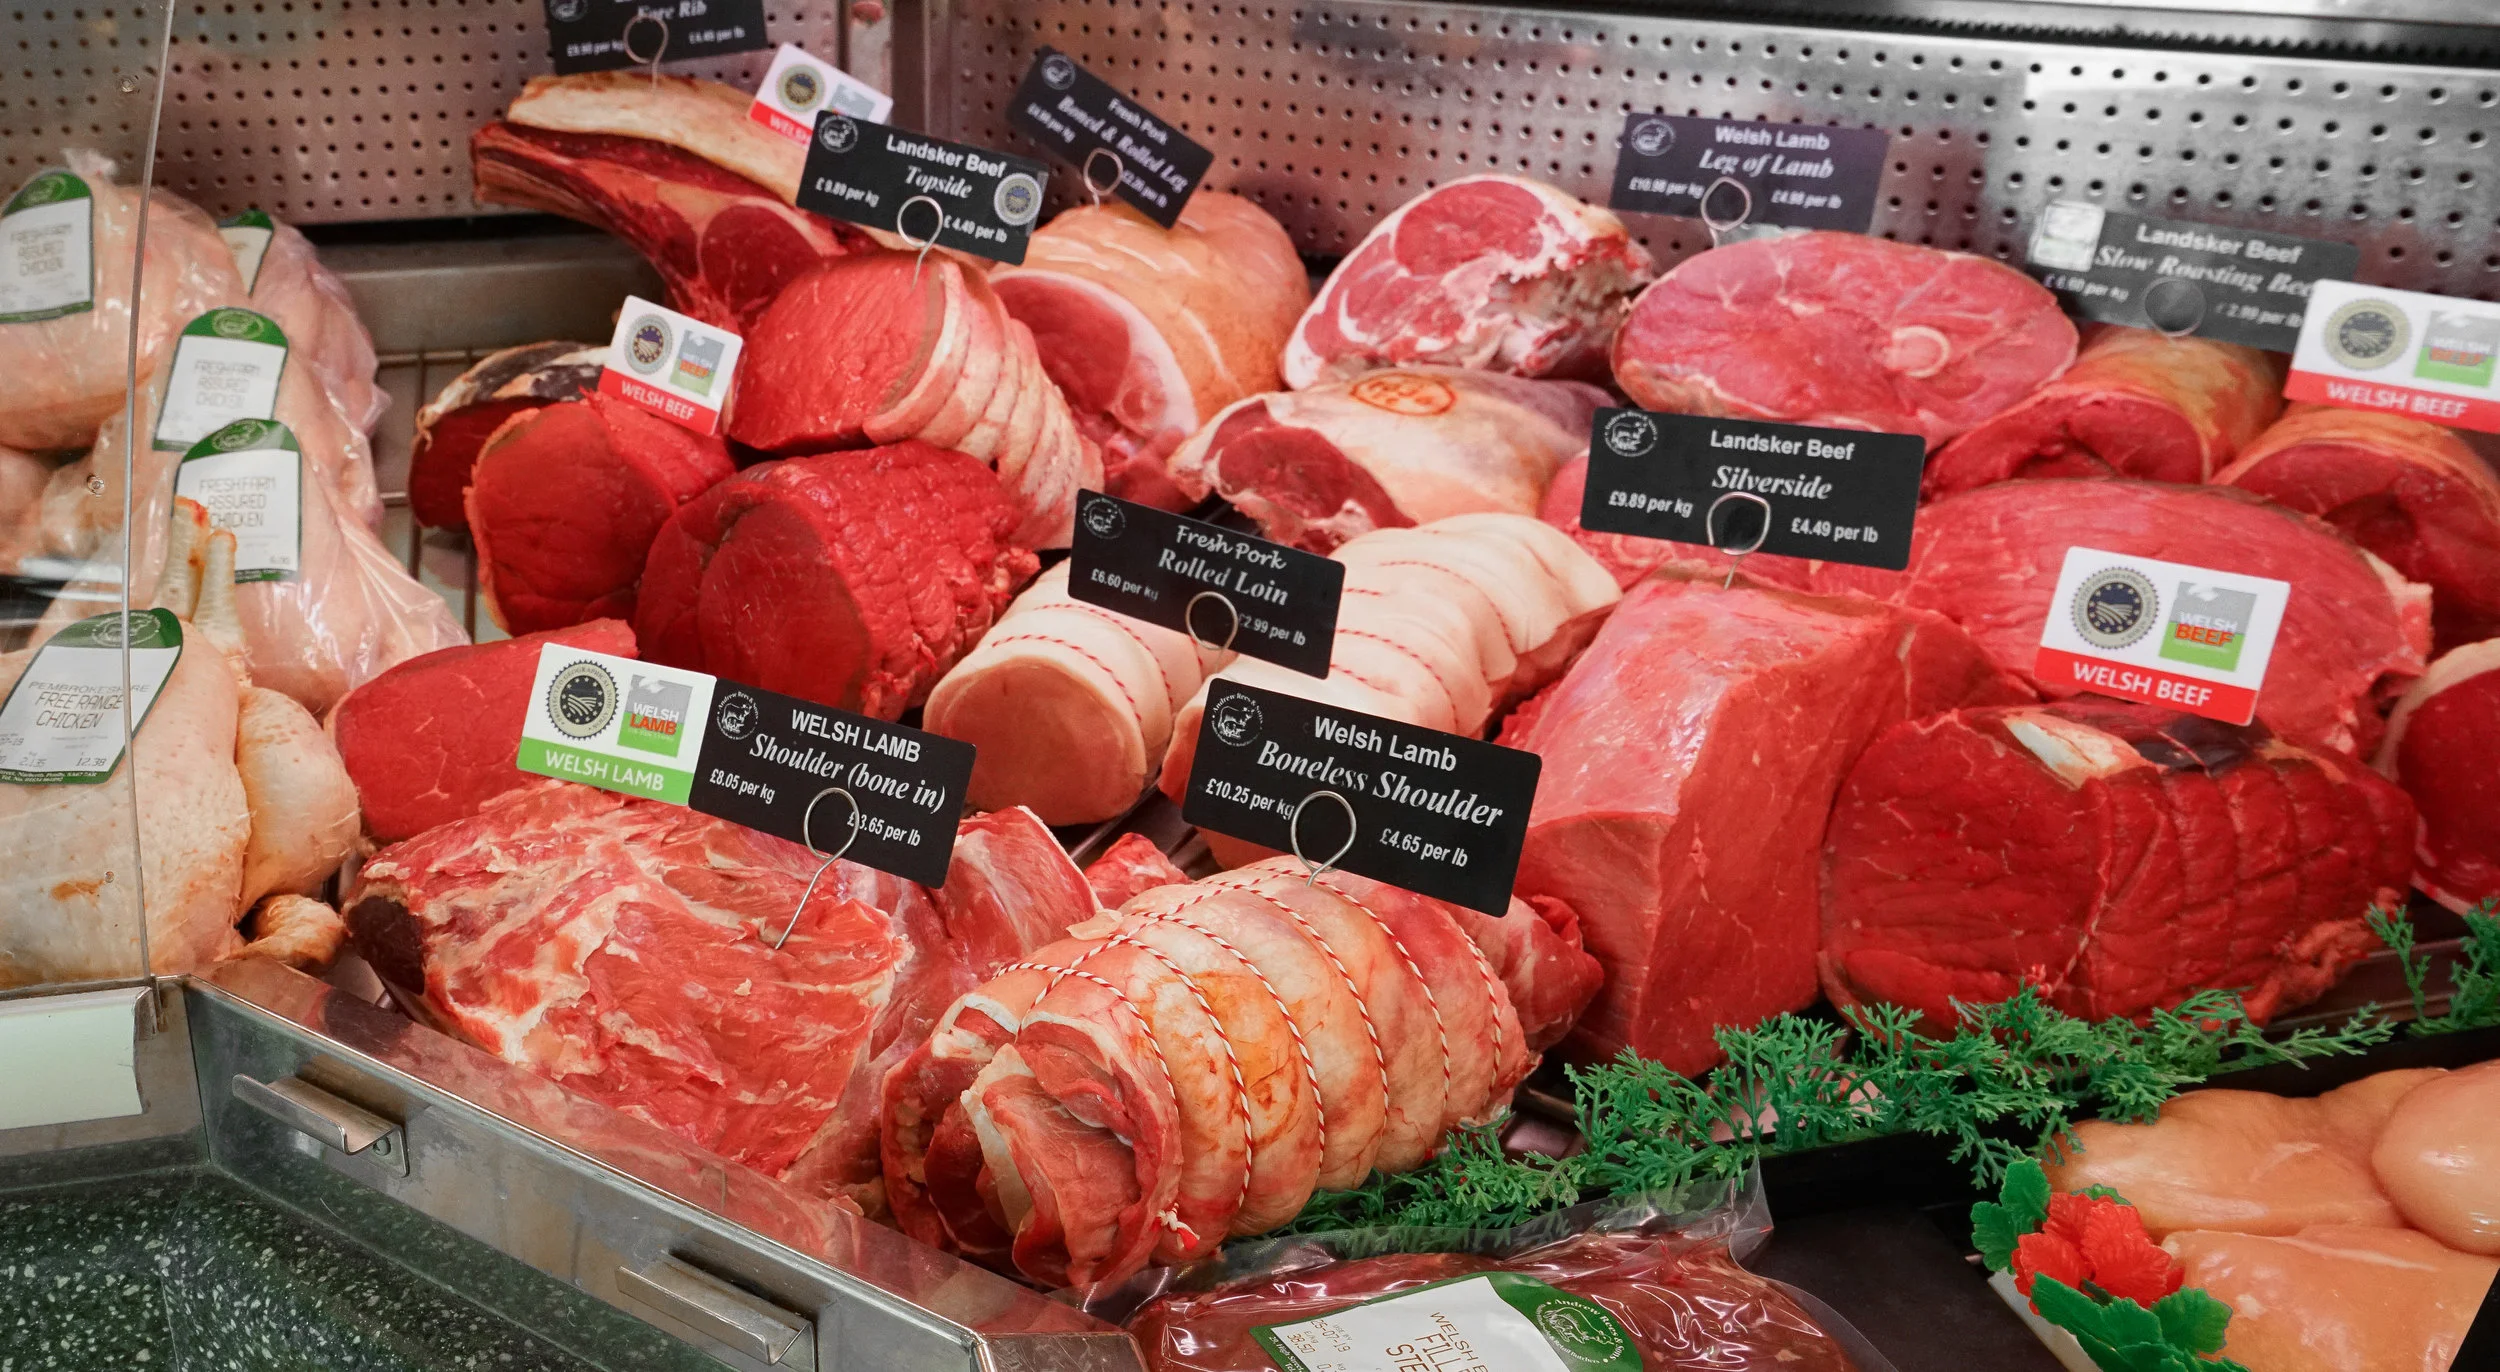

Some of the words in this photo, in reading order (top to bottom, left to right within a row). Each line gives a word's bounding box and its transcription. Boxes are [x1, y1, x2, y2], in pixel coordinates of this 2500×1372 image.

[679, 1, 707, 18] Rib
[1108, 98, 1142, 129] Fresh
[1140, 118, 1168, 145] Pork
[1057, 95, 1106, 134] Boned
[1100, 126, 1118, 143] &
[1116, 133, 1165, 173] Rolled
[1160, 164, 1189, 193] Leg
[1714, 125, 1773, 146] Welsh
[1776, 130, 1830, 151] Lamb
[886, 133, 964, 168] Landsker
[965, 153, 1007, 179] Beef
[1698, 148, 1739, 175] Leg
[1742, 153, 1772, 178] of
[1770, 154, 1835, 179] Lamb
[905, 165, 972, 199] Topside
[1665, 182, 1687, 196] per
[1686, 184, 1705, 199] kg
[844, 186, 866, 201] per
[865, 190, 880, 208] kg
[1803, 195, 1826, 209] per
[1825, 194, 1842, 209] lb
[975, 222, 995, 241] per
[995, 227, 1008, 243] lb
[2136, 223, 2243, 256] Landsker
[2244, 239, 2304, 265] Beef
[2095, 245, 2155, 271] Slow
[2156, 255, 2264, 294] Roasting
[2267, 272, 2313, 297] Bee
[2082, 281, 2109, 297] per
[2110, 285, 2130, 303] kg
[2256, 309, 2286, 326] per
[679, 359, 710, 379] BEEF
[621, 380, 665, 410] WELSH
[665, 397, 696, 420] BEEF
[2325, 381, 2409, 410] WELSH
[2410, 394, 2469, 419] BEEF
[1710, 429, 1803, 456] Landsker
[1806, 439, 1855, 461] Beef
[200, 478, 240, 493] FRESH
[240, 477, 276, 490] FARM
[1711, 464, 1833, 500] Silverside
[1608, 489, 1647, 510] £9.89
[1646, 497, 1672, 515] per
[1674, 499, 1694, 518] kg
[1790, 517, 1832, 538] £4.49
[1833, 526, 1861, 543] per
[1862, 527, 1879, 544] lb
[1175, 524, 1234, 555] Fresh
[1235, 543, 1287, 571] Pork
[1090, 568, 1122, 589] £6.60
[1122, 579, 1142, 595] per
[1157, 548, 1232, 588] Rolled
[1234, 572, 1289, 606] Loin
[2174, 623, 2235, 648] BEEF
[2178, 611, 2238, 632] WELSH
[1268, 626, 1290, 640] per
[1293, 630, 1307, 647] lb
[28, 682, 150, 693] PEMBROKESHRE
[2072, 660, 2153, 696] WELSH
[2155, 679, 2213, 708] BEEF
[35, 692, 76, 710] FREE
[75, 694, 124, 710] RANGE
[633, 702, 679, 723] WELSH
[718, 693, 737, 710] Andrew
[1213, 695, 1236, 713] Andrew
[36, 710, 104, 729] CHICKEN
[630, 713, 677, 736] LAMB
[791, 709, 860, 747] WELSH
[863, 729, 921, 764] LAMB
[1314, 715, 1384, 754] Welsh
[1388, 733, 1459, 773] Lamb
[545, 749, 608, 780] WELSH
[612, 764, 665, 792] LAMB
[749, 732, 845, 781] Shoulder
[847, 762, 910, 800] (bone
[912, 779, 947, 815] in)
[1257, 739, 1369, 792] Boneless
[1372, 770, 1504, 829] Shoulder
[709, 768, 739, 790] £8.05
[738, 780, 760, 796] per
[760, 784, 776, 805] kg
[1205, 777, 1251, 805] £10.25
[1250, 793, 1275, 812] per
[1276, 797, 1296, 821] kg
[883, 822, 908, 842] per
[908, 828, 921, 847] lb
[1379, 828, 1420, 853] £4.65
[1421, 842, 1450, 862] per
[1452, 846, 1469, 869] lb
[1311, 1320, 1351, 1352] 25-07-19
[1430, 1312, 1479, 1361] WELSH
[1555, 1299, 1600, 1315] Andrew
[1600, 1316, 1618, 1336] Rees
[1610, 1345, 1624, 1360] Sons
[1276, 1343, 1290, 1356] High
[1554, 1340, 1571, 1354] Retail
[1571, 1351, 1600, 1364] Butchers
